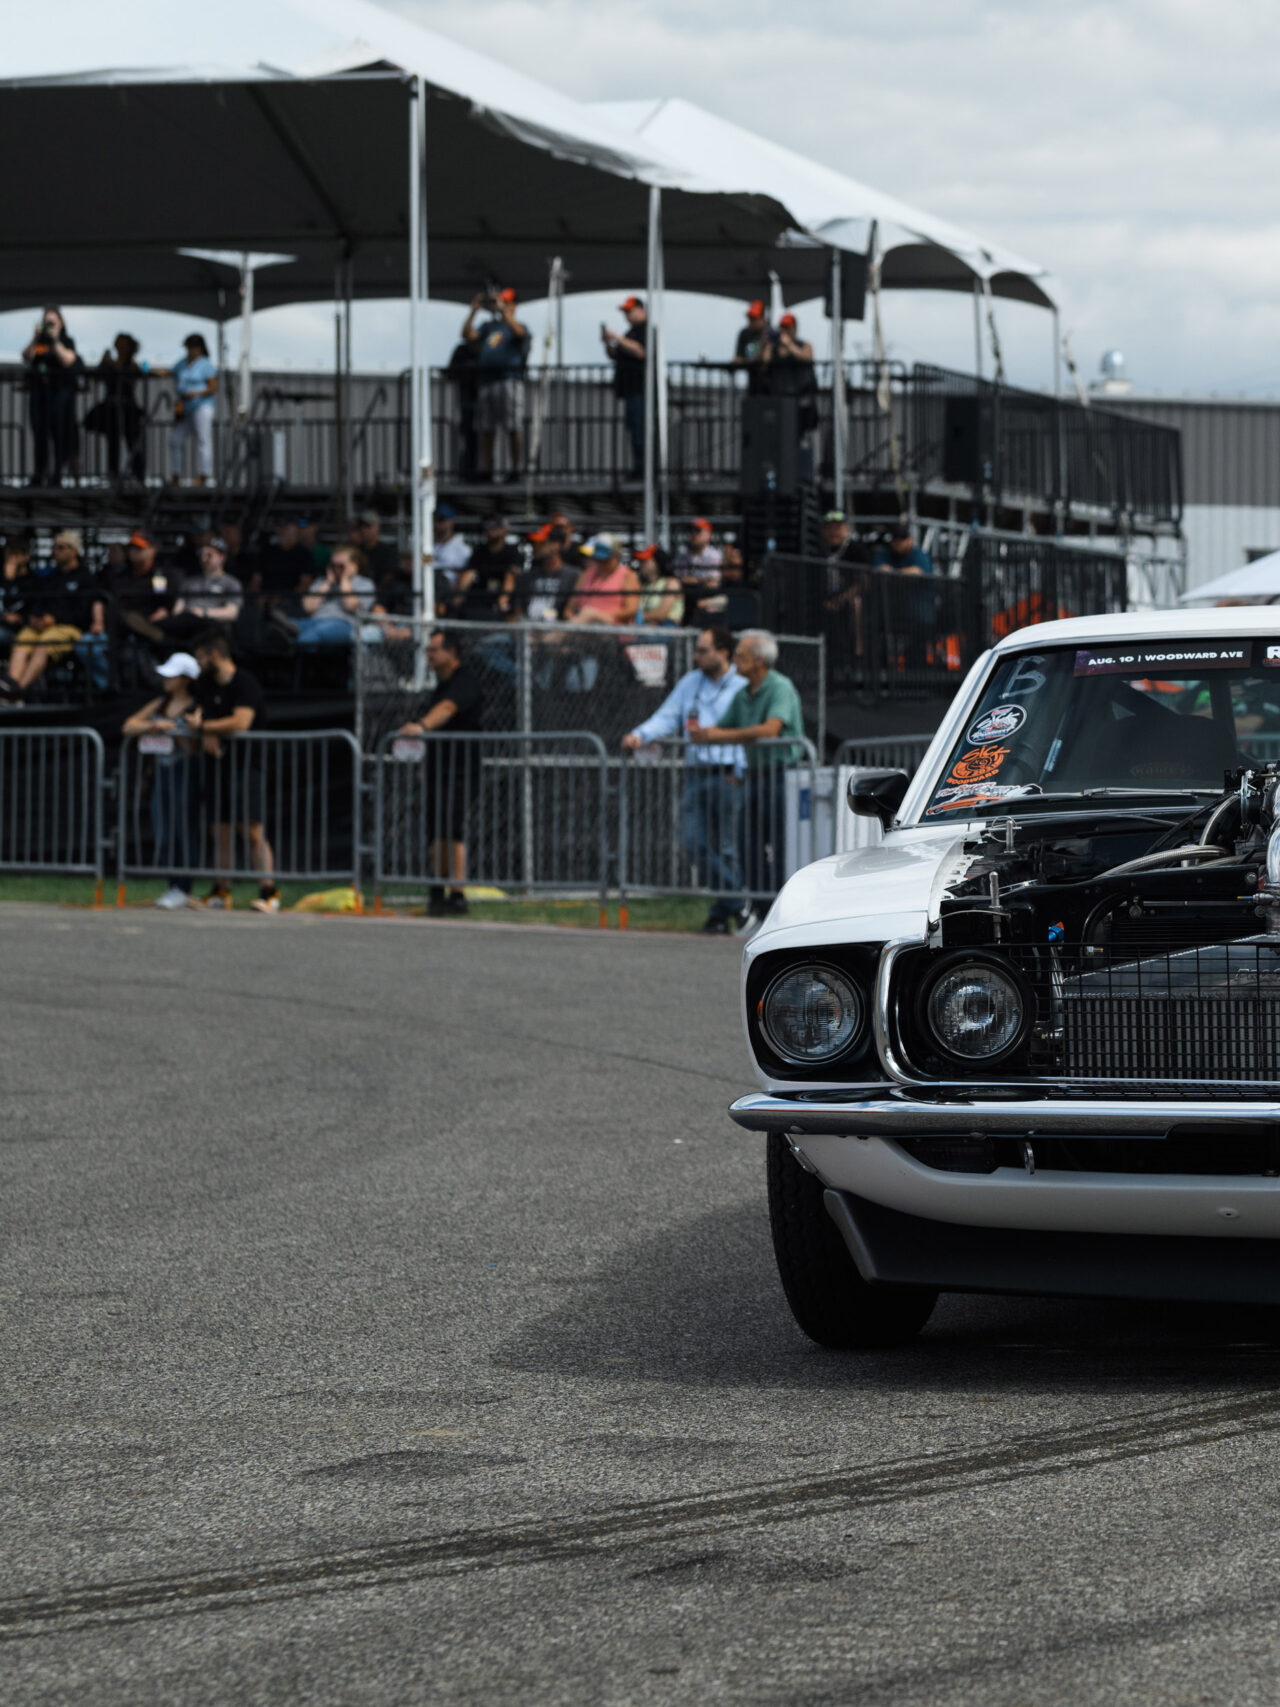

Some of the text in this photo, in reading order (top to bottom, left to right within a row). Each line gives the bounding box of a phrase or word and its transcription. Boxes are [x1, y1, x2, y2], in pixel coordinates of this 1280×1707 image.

[1088, 657, 1116, 666] AUG.
[1145, 652, 1217, 662] WOODWARD
[1220, 651, 1243, 659] AVE
[961, 745, 1011, 763] SICK
